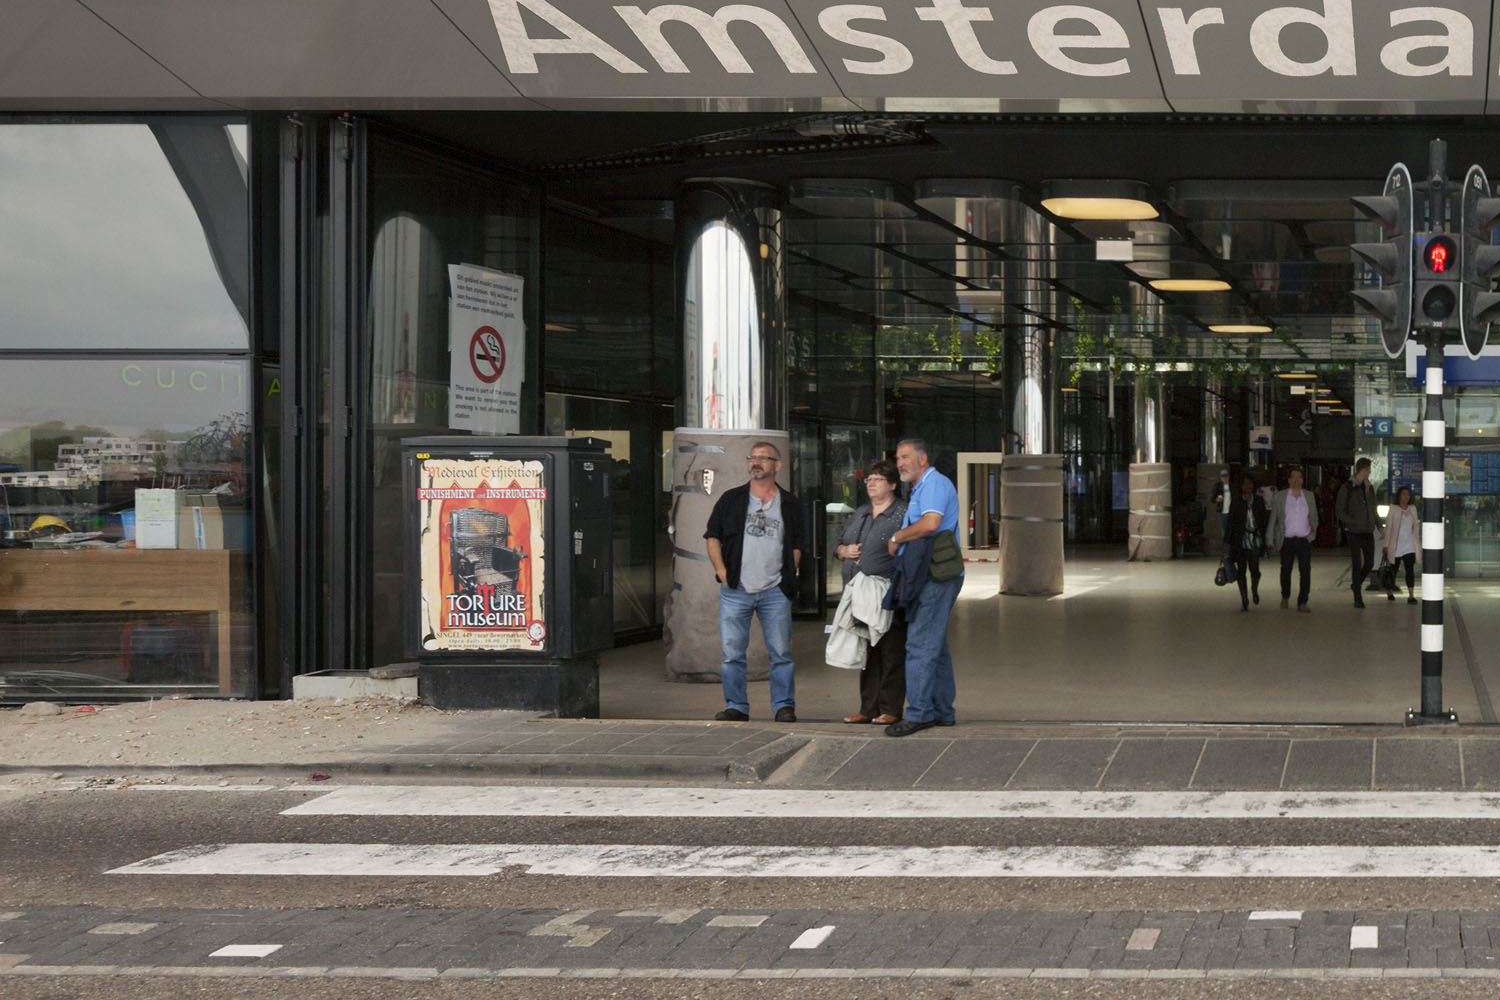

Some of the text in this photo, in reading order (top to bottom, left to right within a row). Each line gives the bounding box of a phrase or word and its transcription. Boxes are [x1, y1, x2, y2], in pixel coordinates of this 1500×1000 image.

[1392, 174, 1401, 189] 712
[122, 365, 280, 397] CUCIA
[1378, 422, 1388, 433] G
[427, 465, 539, 480] Medieval Exhibition
[420, 488, 475, 499] PUNISHMENT
[486, 488, 546, 499] INSTRUMENTS
[446, 583, 526, 614] TORTURE
[448, 612, 526, 626] museum
